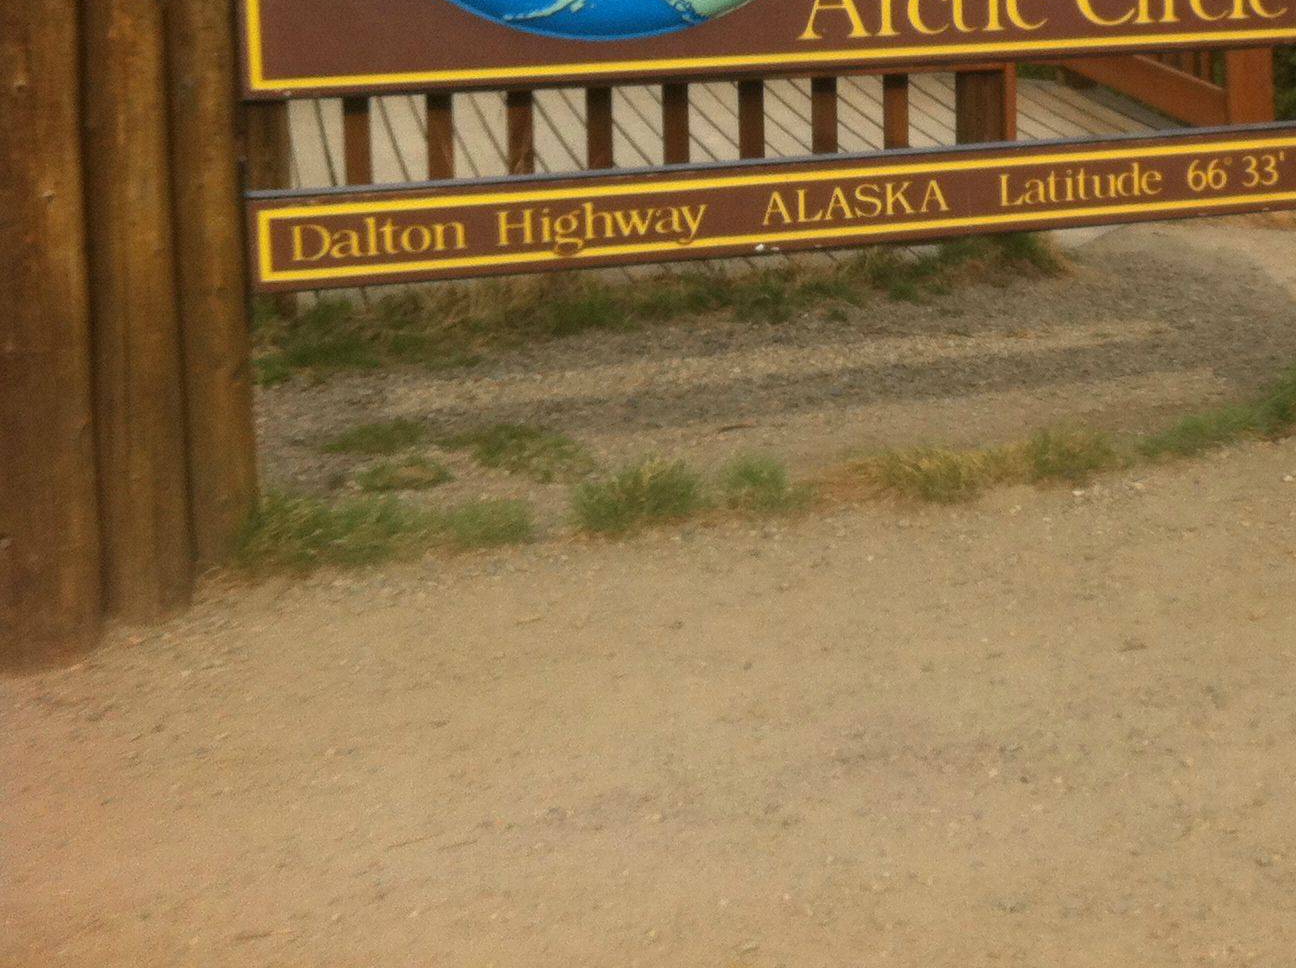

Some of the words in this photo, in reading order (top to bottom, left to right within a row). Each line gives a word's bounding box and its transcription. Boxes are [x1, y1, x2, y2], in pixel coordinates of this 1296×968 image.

[291, 214, 467, 261] Dalton
[496, 201, 708, 254] Highway
[761, 179, 950, 226] ALASKA
[999, 162, 1163, 207] Latitude
